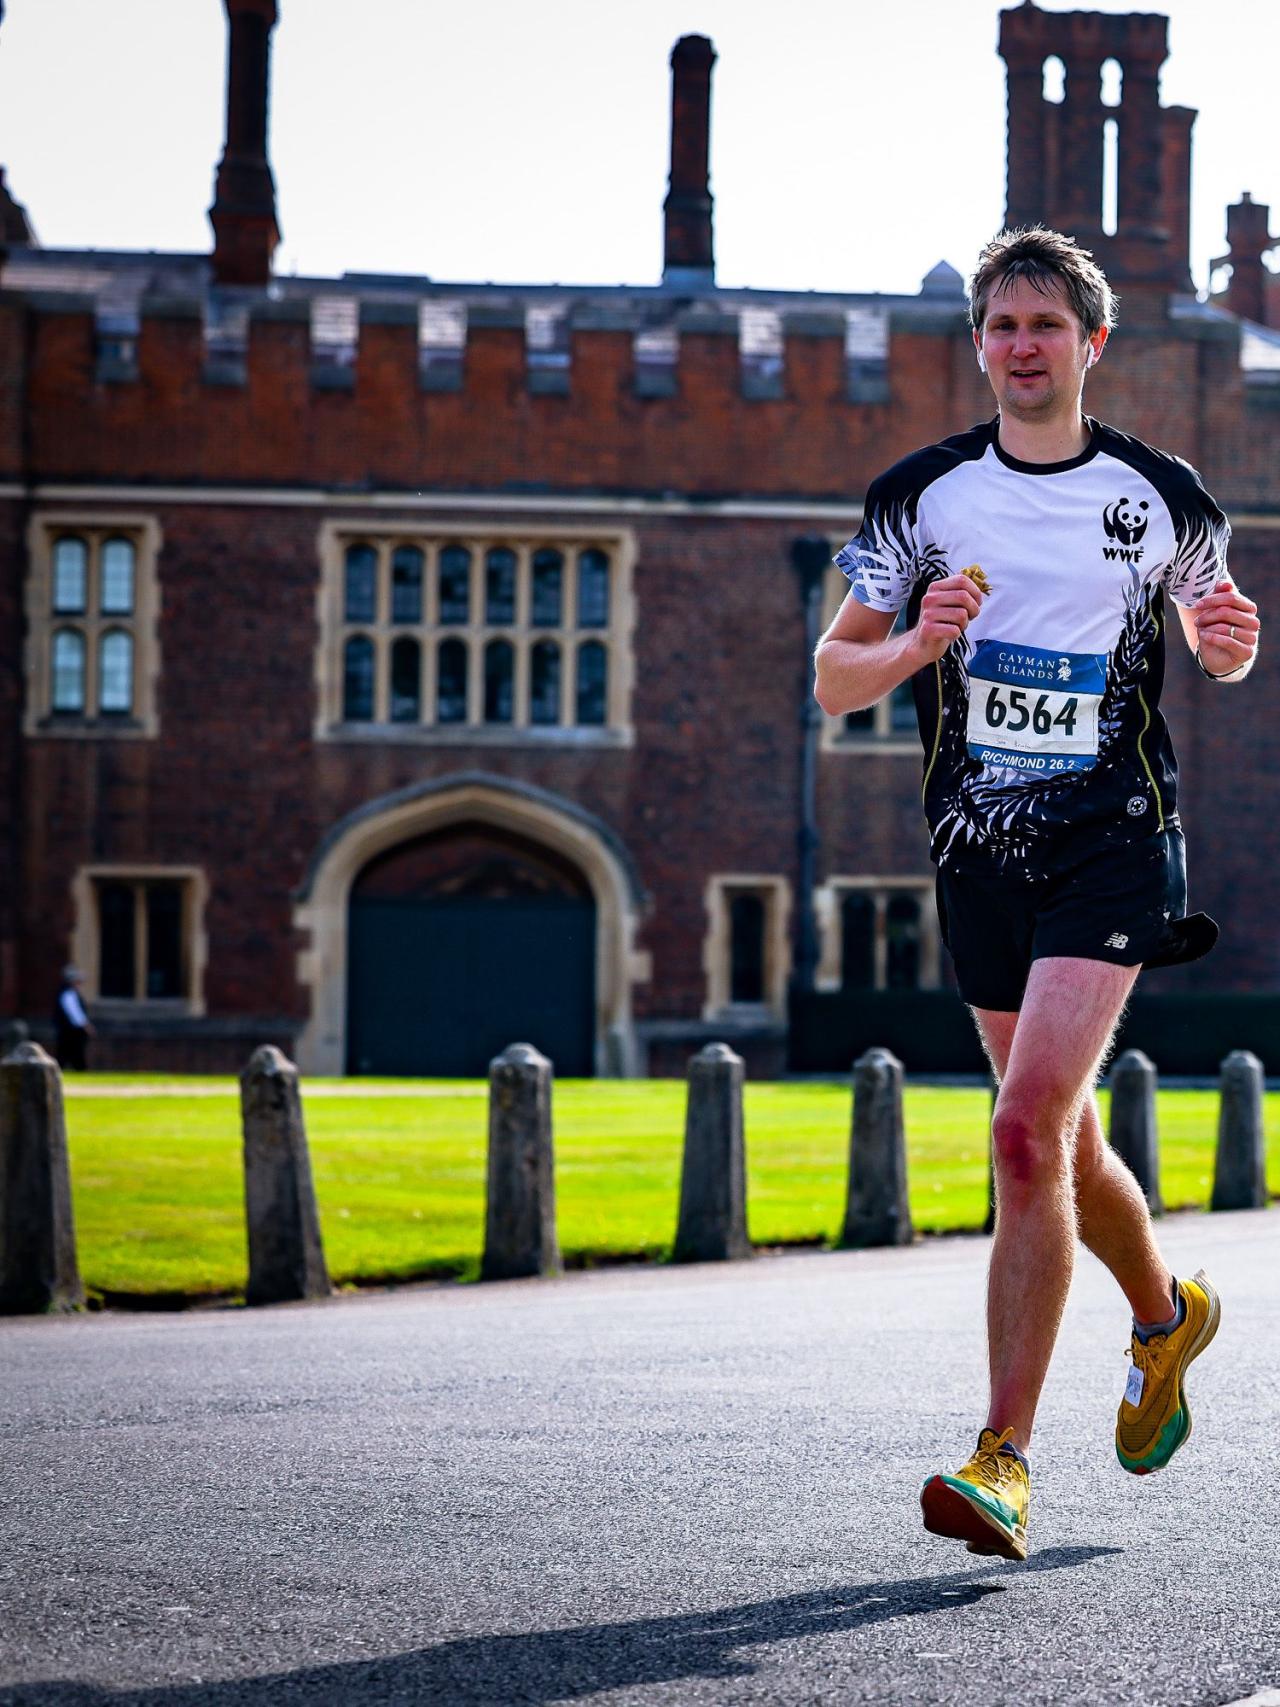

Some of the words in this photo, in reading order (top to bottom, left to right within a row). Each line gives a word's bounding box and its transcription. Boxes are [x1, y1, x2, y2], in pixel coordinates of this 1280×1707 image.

[1103, 548, 1144, 563] WWF
[998, 653, 1055, 669] CAYMAN
[997, 663, 1053, 679] ISLANDS
[985, 687, 1078, 735] 6564
[980, 750, 1045, 769] RICHMOND
[1049, 759, 1074, 770] 26.2
